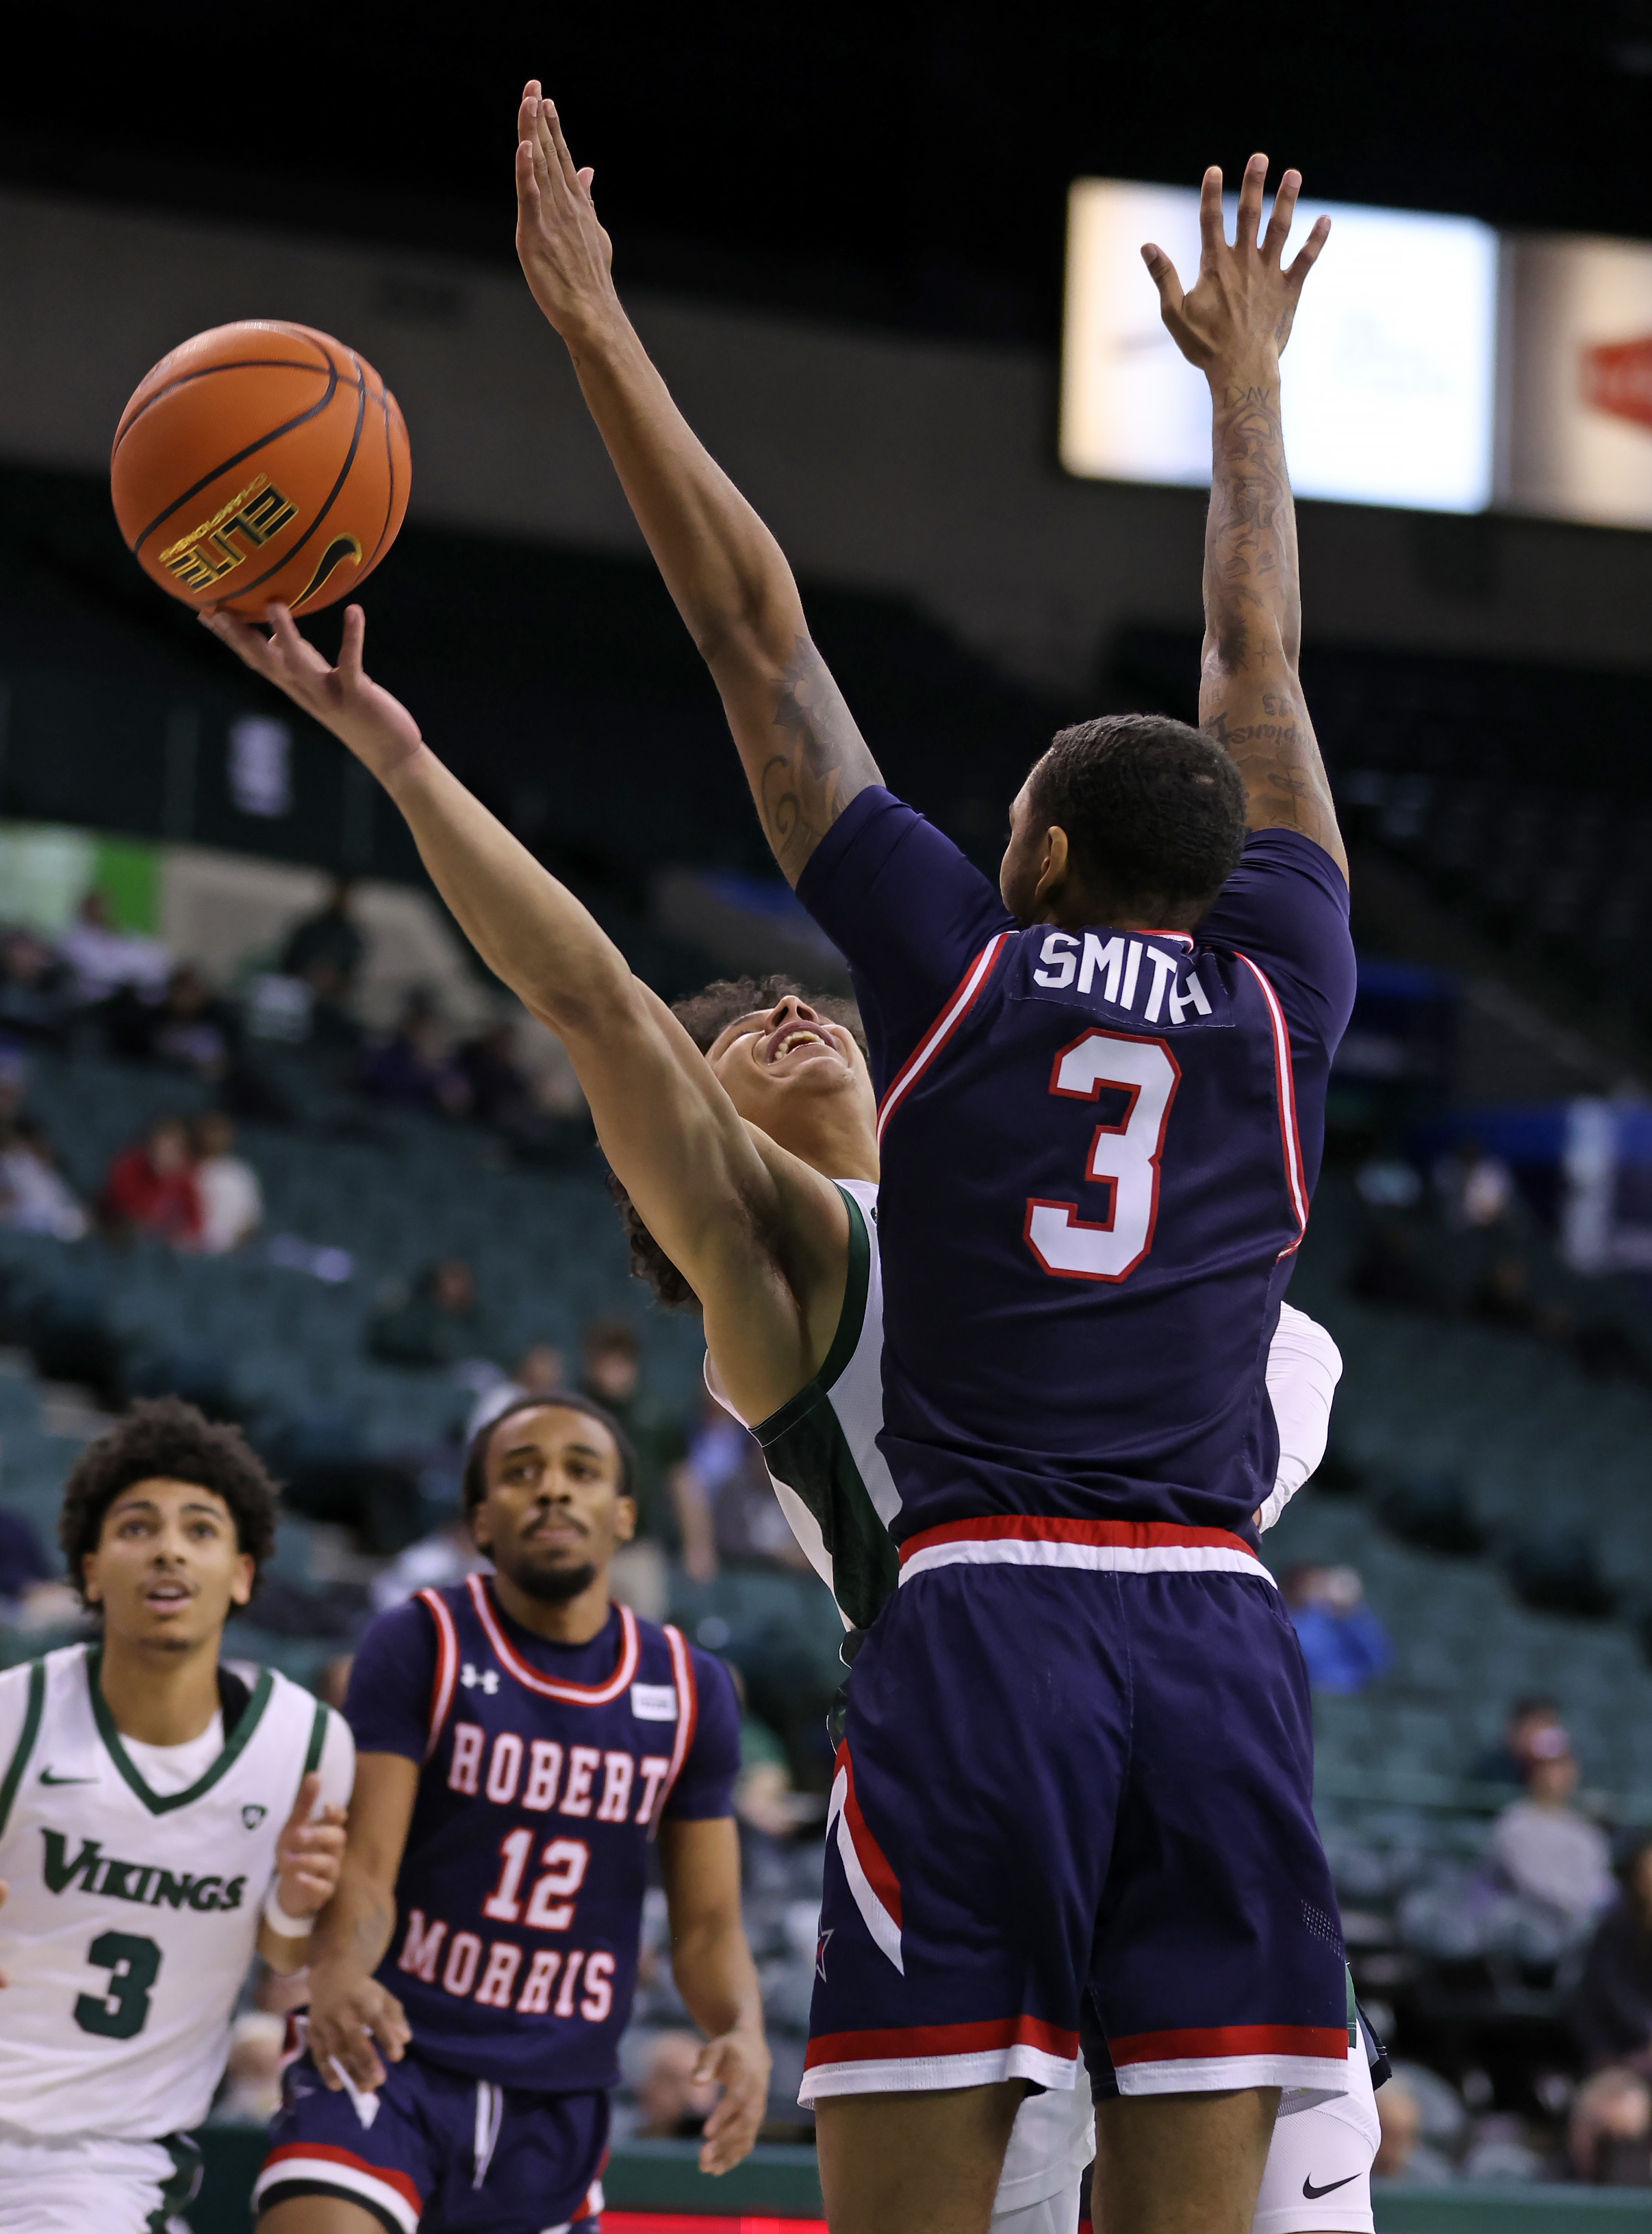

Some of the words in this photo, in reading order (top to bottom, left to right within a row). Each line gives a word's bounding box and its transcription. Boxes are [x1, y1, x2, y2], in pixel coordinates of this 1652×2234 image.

[165, 482, 299, 594] ELITE
[1033, 932, 1212, 1024] SMITH
[1025, 1028, 1181, 1282] 3
[448, 1721, 672, 1825] ROBERT
[39, 1826, 249, 1913] VIKINGS
[482, 1827, 591, 1931] 12
[74, 1930, 162, 2040] 3
[398, 1908, 617, 2022] MORRIS
